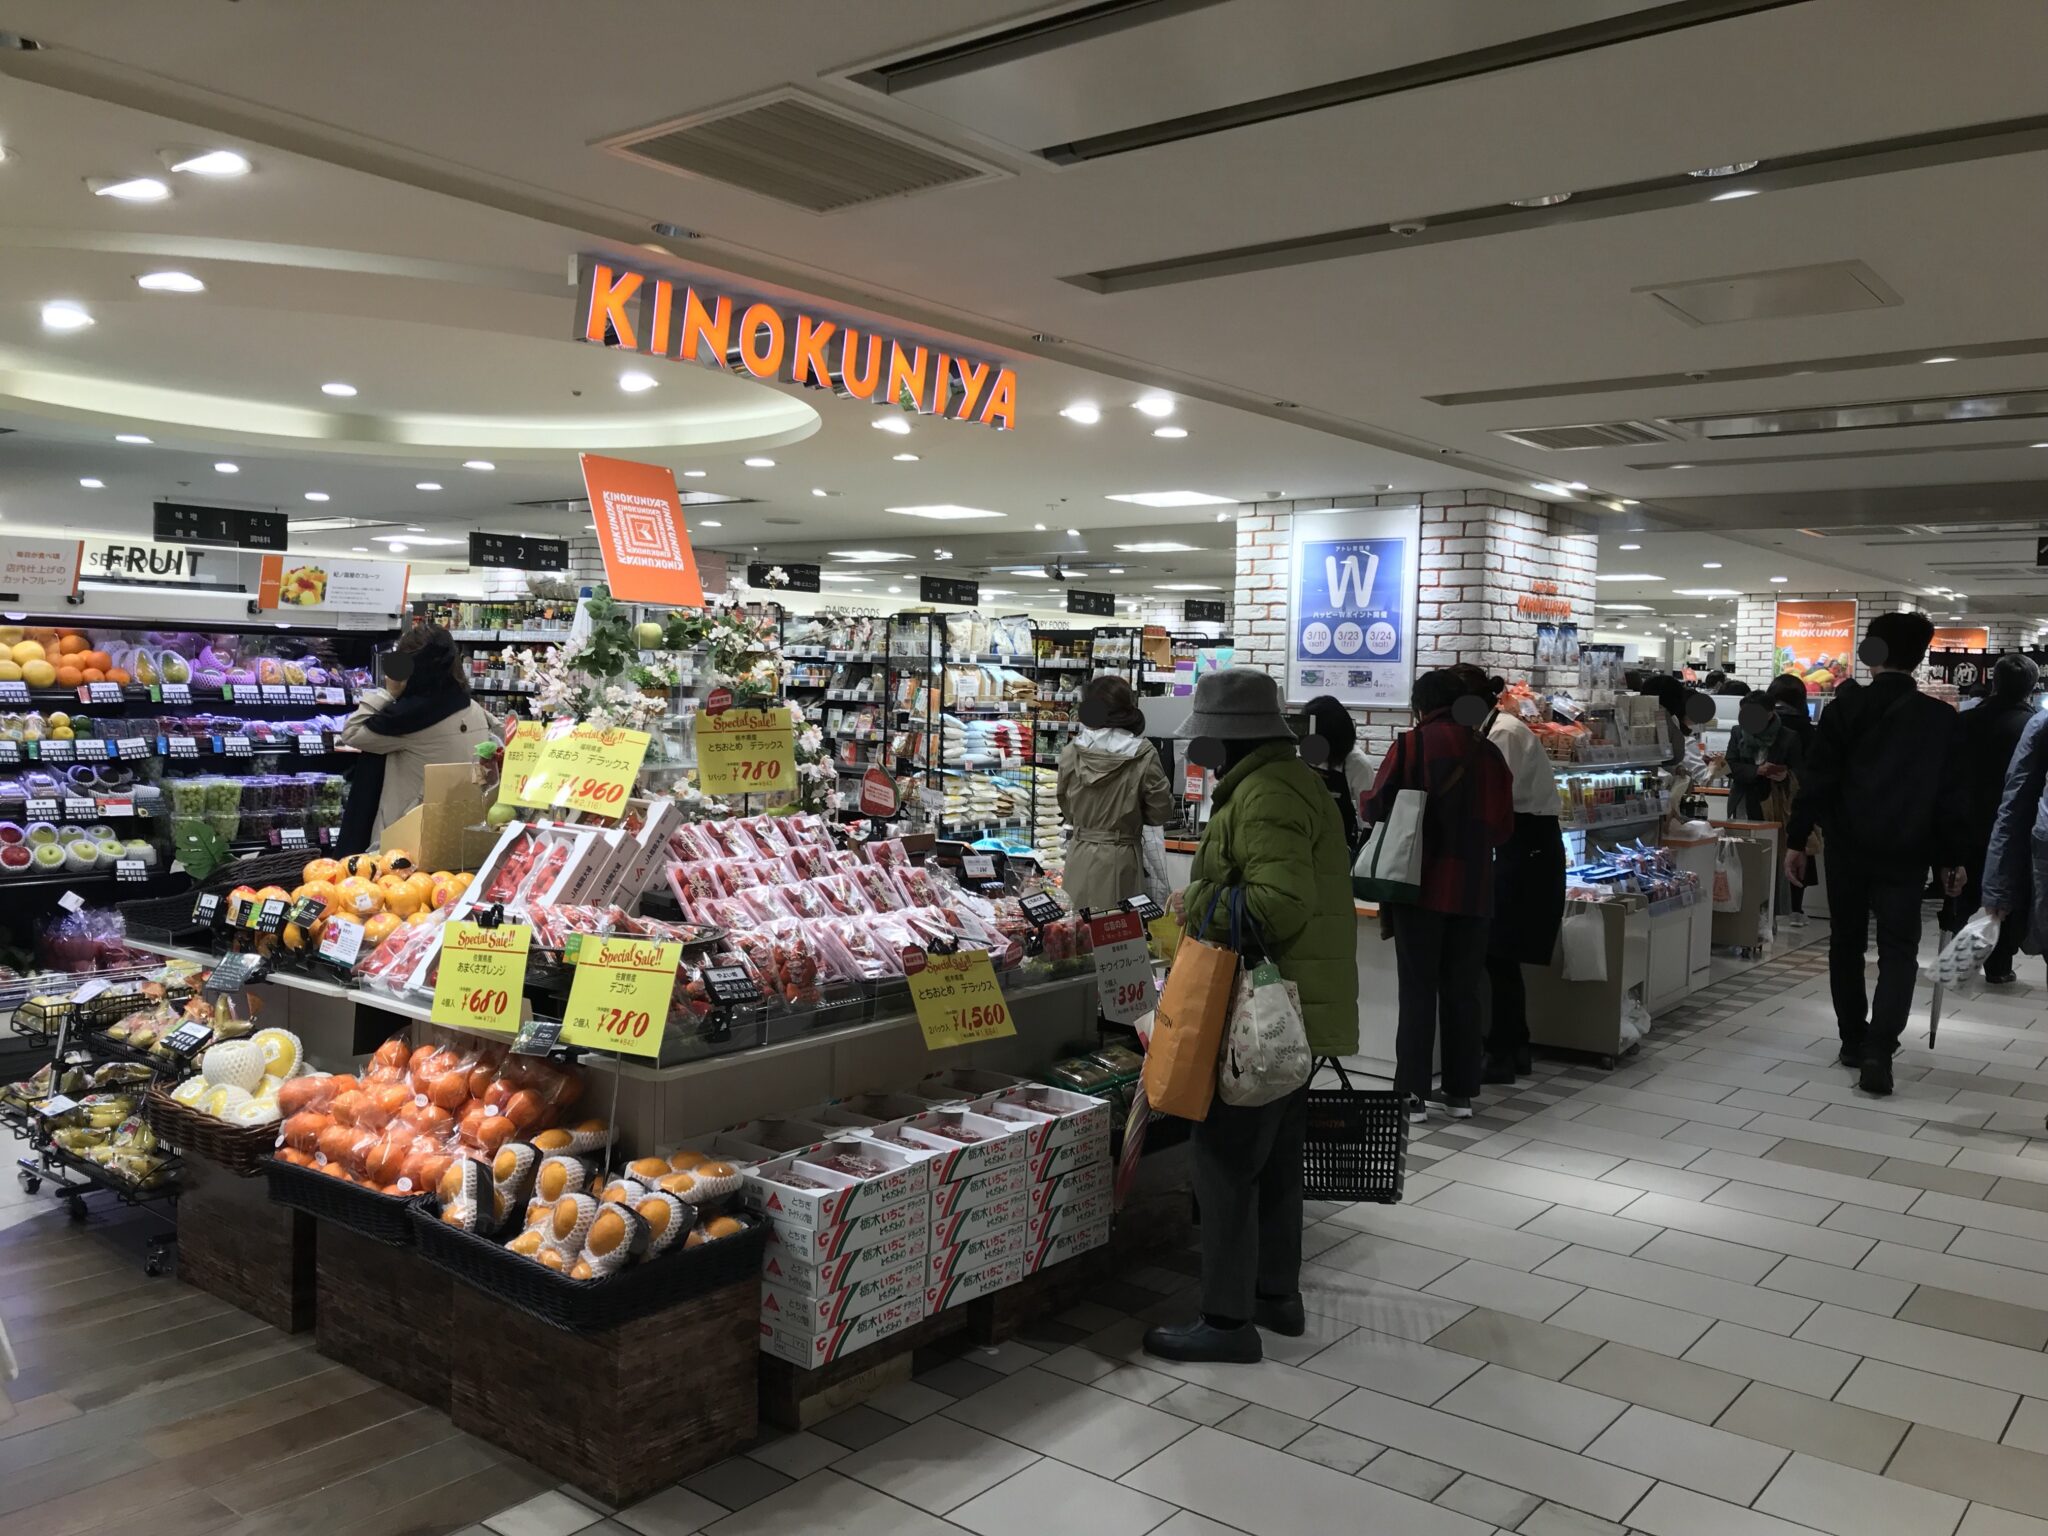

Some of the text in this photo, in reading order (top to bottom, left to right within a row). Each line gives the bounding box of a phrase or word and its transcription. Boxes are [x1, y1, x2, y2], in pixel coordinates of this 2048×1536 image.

[584, 264, 1017, 430] KINOKUNIYA
[603, 491, 668, 507] KINOKUNIYA
[220, 521, 226, 535] 1
[105, 545, 205, 577] FRUIT
[517, 548, 524, 559] 2
[5, 564, 66, 575] 店内仕上げの
[2, 575, 66, 586] カットフルーツ
[1326, 555, 1379, 608] W
[1307, 631, 1326, 640] 3/10
[1338, 631, 1359, 640] 3/23
[1370, 631, 1391, 640] 3/24
[1782, 629, 1849, 637] KINOKUNIYA
[713, 712, 776, 733] Special Sale!!
[570, 729, 625, 746] Special Sale!!
[708, 741, 784, 752] とちおとめ デラックス
[548, 749, 630, 771] あまおう デラックス
[732, 760, 780, 781] ¥780
[458, 929, 515, 949] Special Sale!!
[599, 943, 664, 968] Special Sale!!
[926, 956, 952, 975] Special
[1100, 954, 1146, 972] キウイフルーツ
[457, 962, 506, 976] あまくさオレンジ
[615, 972, 637, 982] 佐賀県産
[609, 981, 638, 995] デコポン
[919, 981, 994, 1000] とちおとめ デラックス
[441, 998, 455, 1008] 4個入
[461, 989, 508, 1015] ¥680
[573, 1017, 589, 1029] 2個入
[597, 1008, 650, 1038] ¥780
[953, 1003, 1004, 1031] ¥1,560
[929, 1024, 951, 1034] 2パック入
[1059, 1112, 1093, 1132] 栃木いちご
[968, 1138, 1007, 1160] 栃木いちご
[1060, 1141, 1094, 1160] 栃木いちご
[863, 1173, 906, 1196] 栃木いちご
[970, 1169, 1008, 1193] 栃木いちご
[1062, 1169, 1097, 1189] 栃木いちご
[792, 1197, 811, 1210] とちぎ
[971, 1200, 1009, 1222] 栃木いちご
[1062, 1196, 1096, 1218] 栃木いちご
[860, 1204, 905, 1231] 栃木いちご
[968, 1232, 1006, 1255] 栃木いちご
[1056, 1227, 1092, 1249] 栃木いちご
[862, 1237, 906, 1262] 栃木いちご
[859, 1270, 903, 1298] 栃木いちご
[963, 1263, 1004, 1288] 栃木いちご
[857, 1303, 902, 1334] 栃木いちご
